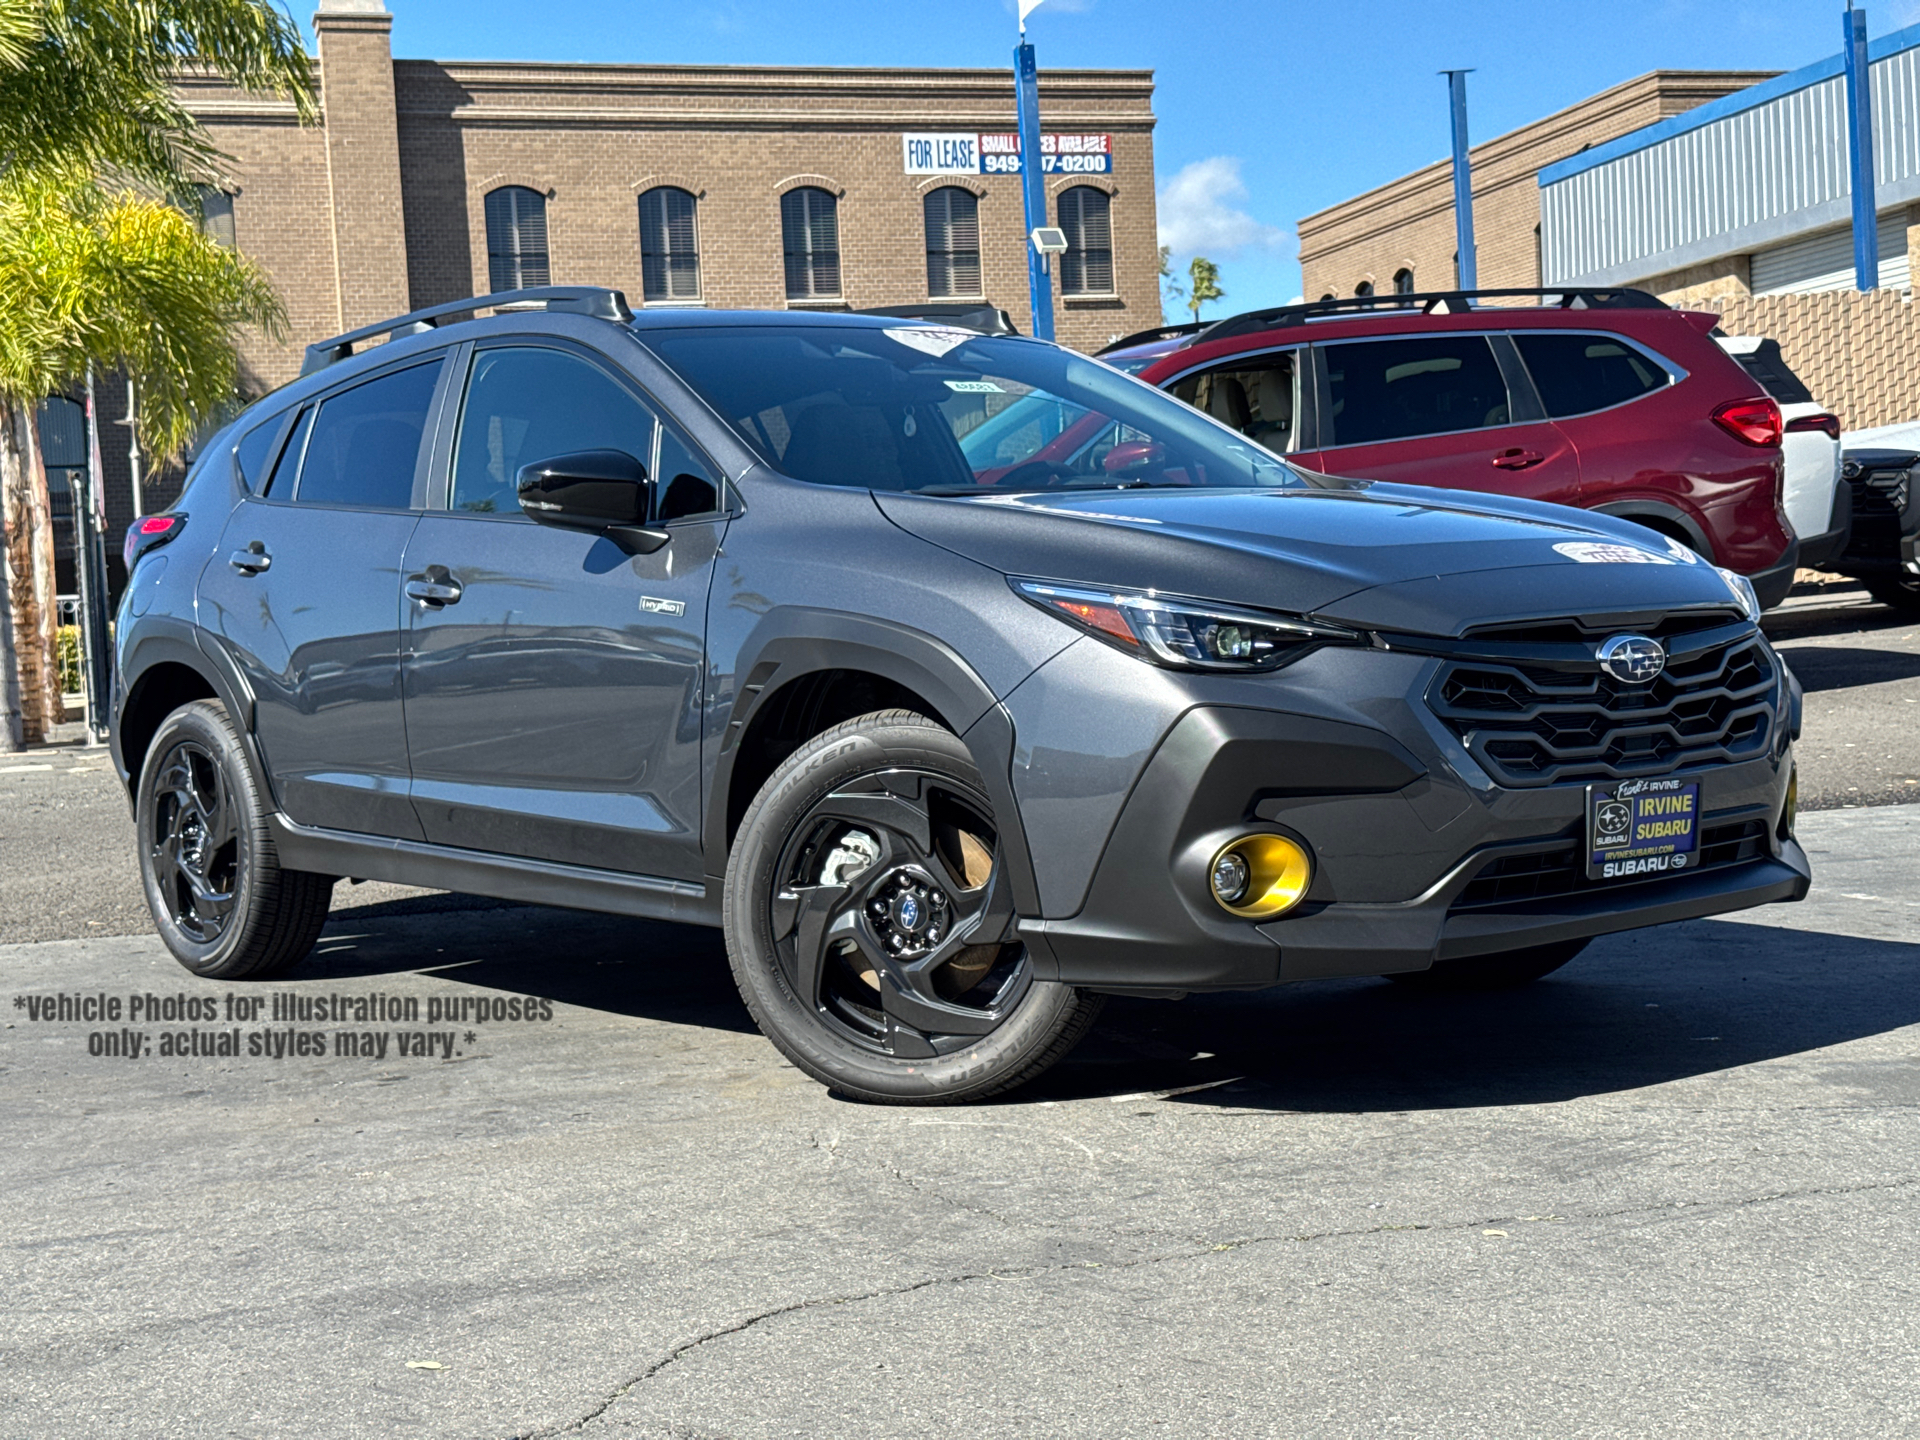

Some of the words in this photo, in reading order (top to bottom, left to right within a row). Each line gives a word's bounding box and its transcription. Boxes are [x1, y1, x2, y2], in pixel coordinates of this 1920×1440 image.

[981, 135, 1016, 153] SMALL
[908, 139, 932, 169] FOR
[937, 139, 975, 169] LEASE
[985, 154, 1106, 173] 949-7-0200
[1649, 780, 1680, 792] IRVINE
[1638, 794, 1693, 817] IRVINE
[1636, 819, 1692, 840] SUBARU
[1596, 834, 1628, 846] SUBARU
[1605, 844, 1675, 861] IRVINESUBARU.COM
[1603, 855, 1669, 878] SUBARU
